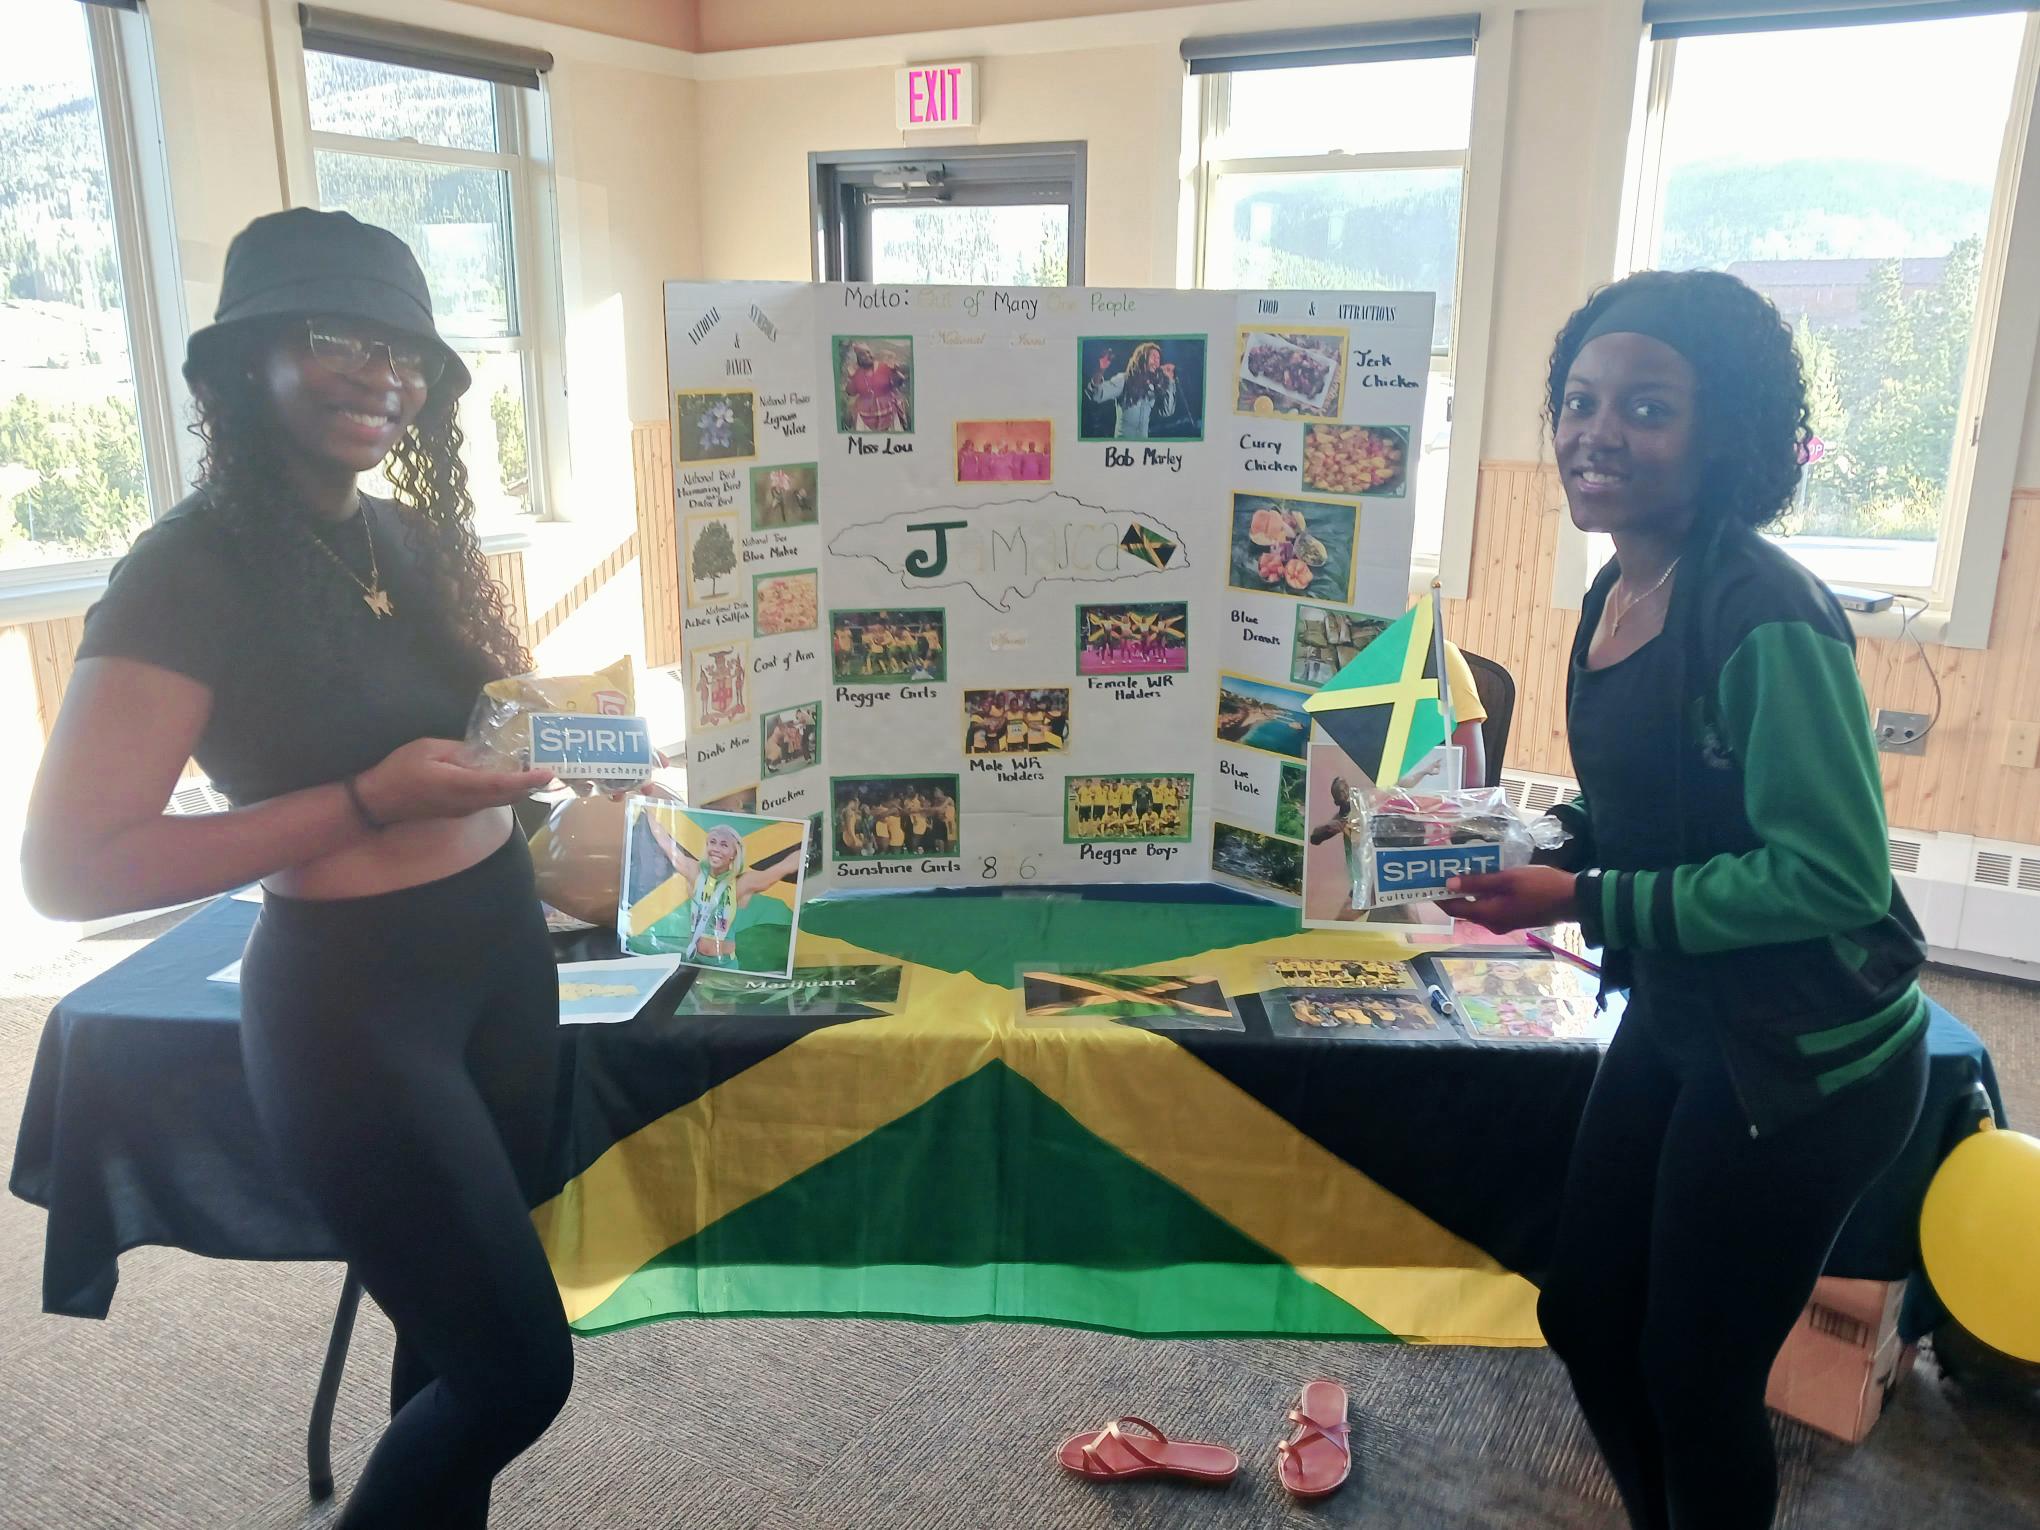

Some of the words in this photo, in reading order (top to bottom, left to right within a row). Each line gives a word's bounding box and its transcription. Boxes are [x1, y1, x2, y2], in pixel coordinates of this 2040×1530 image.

[909, 68, 961, 123] EXIT
[963, 290, 985, 317] of
[994, 291, 1038, 320] Many
[1091, 293, 1136, 316] People
[1258, 299, 1279, 314] FOOD
[1339, 304, 1396, 321] ATTRACTIONS
[1354, 350, 1392, 367] Jerk
[1362, 374, 1420, 389] Chicken
[882, 438, 913, 455] Lou
[1239, 433, 1283, 455] Curry
[1105, 446, 1135, 468] Bob
[1142, 447, 1183, 473] Marley
[1244, 459, 1298, 473] Chicken
[742, 550, 765, 562] Blue
[1231, 609, 1259, 625] Blue
[1088, 676, 1138, 689] Female
[1147, 675, 1174, 688] WR
[836, 686, 891, 708] Reggae
[900, 685, 938, 700] Girls
[1115, 688, 1161, 701] Holders
[540, 727, 645, 754] SPIRIT
[596, 766, 650, 776] exchange
[969, 758, 1003, 772] Male
[1011, 756, 1042, 770] WR
[1220, 760, 1249, 779] Blue
[997, 771, 1045, 782] Holders
[1234, 779, 1260, 796] Hole
[1080, 838, 1138, 865] Reggae
[1146, 843, 1179, 861] Boys
[837, 861, 913, 877] Sunshine
[920, 859, 961, 874] Girls
[1382, 855, 1496, 882] SPIRIT
[1379, 890, 1433, 903] cultural
[745, 979, 857, 990] Marijuana
